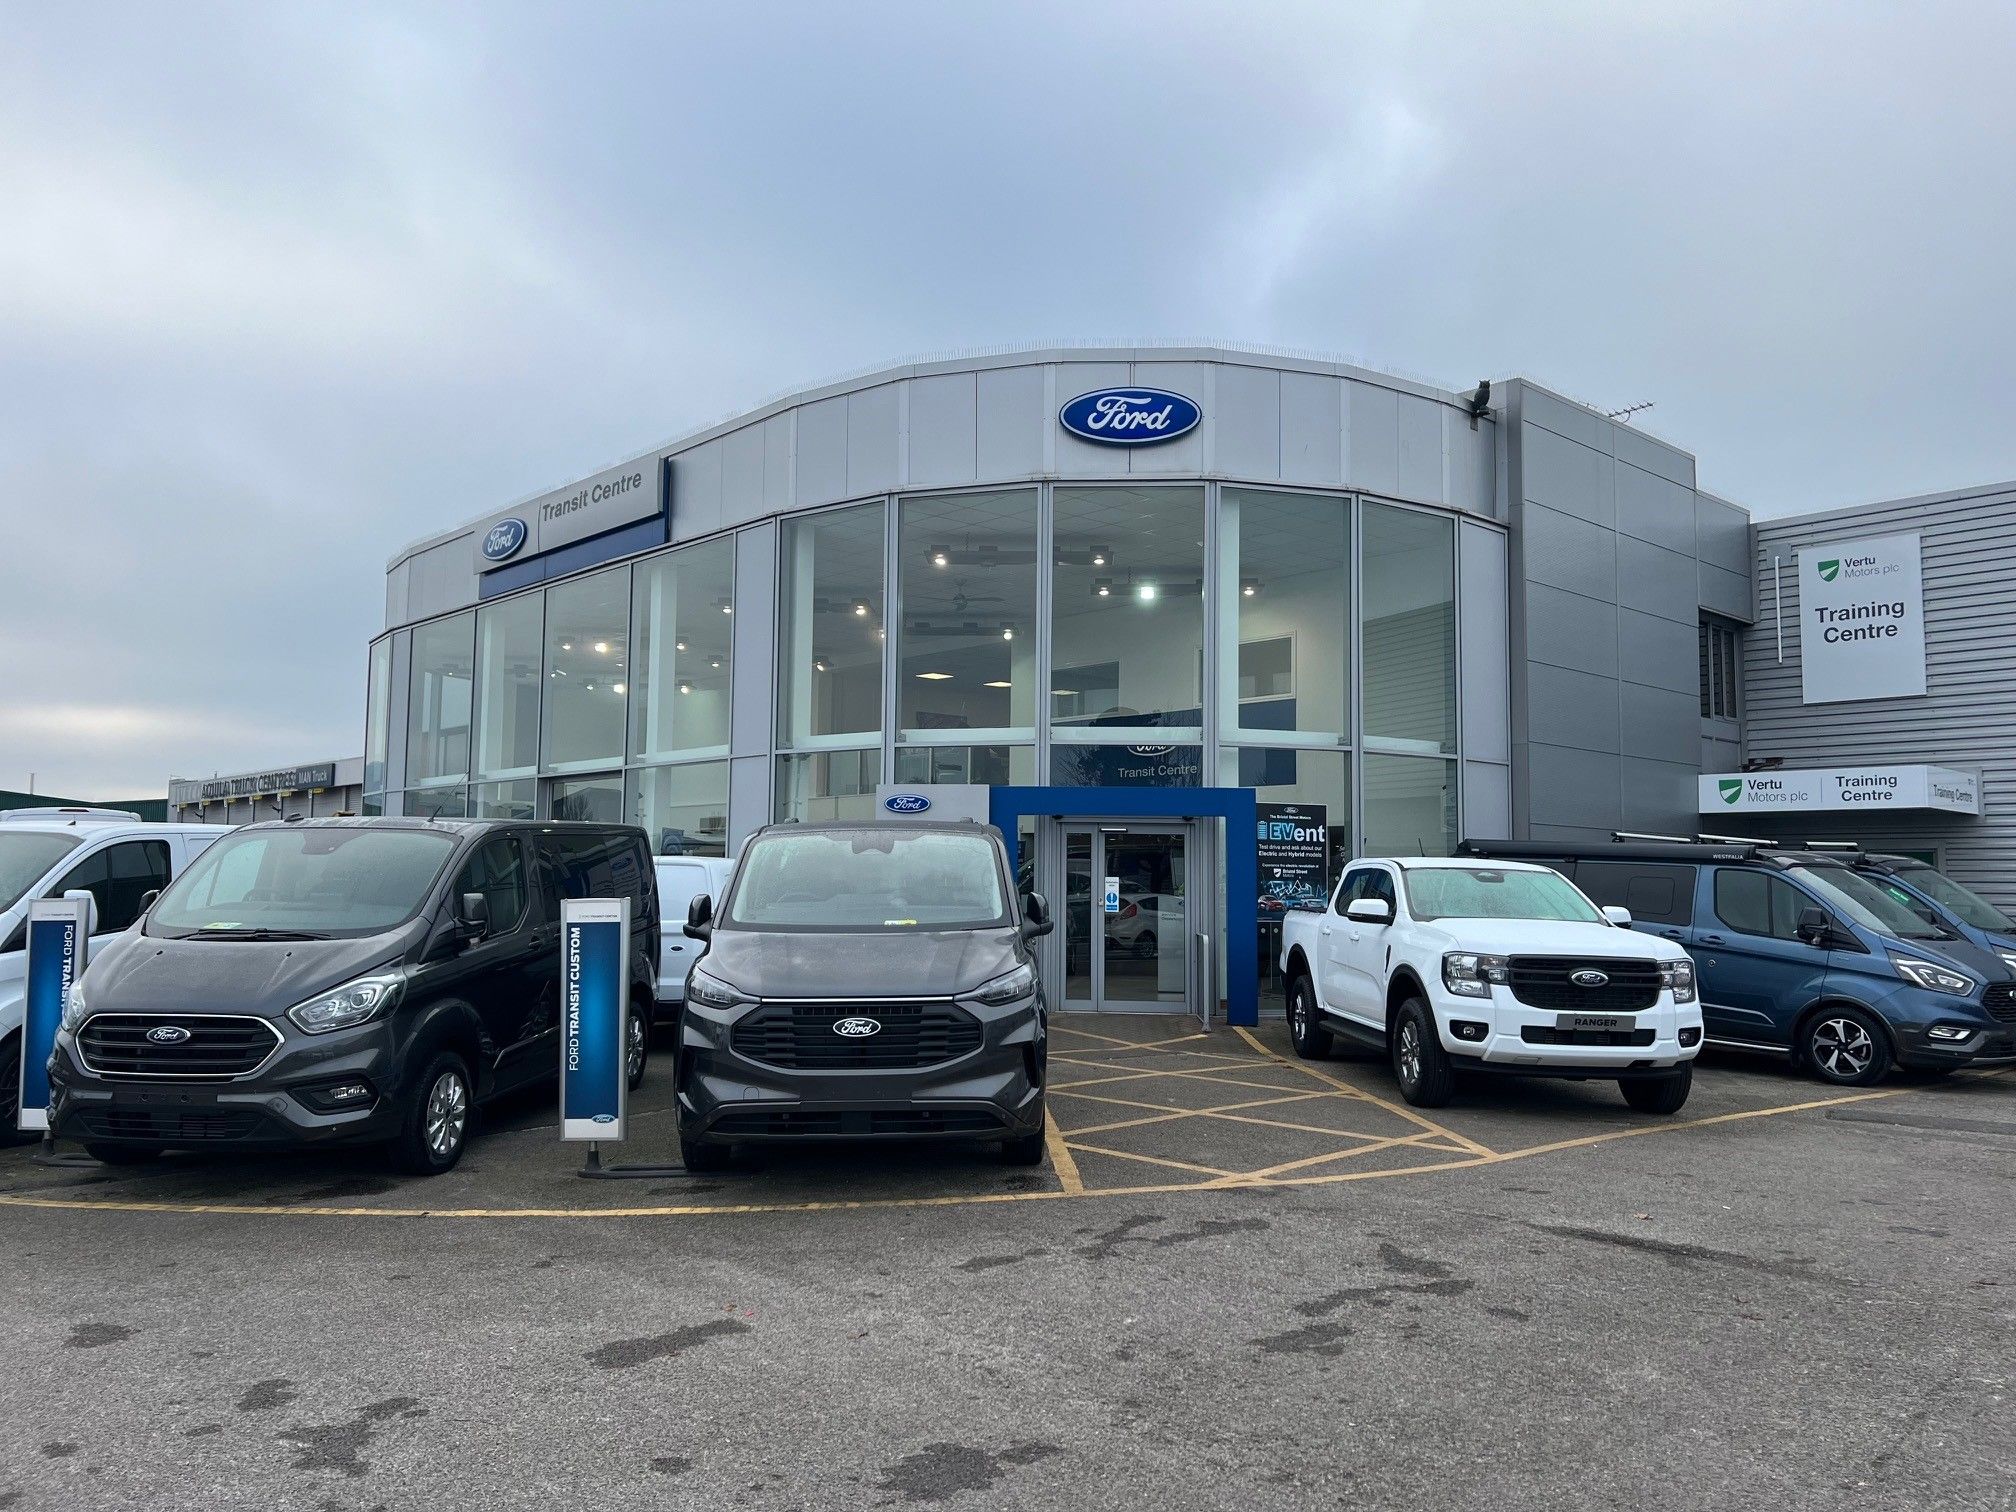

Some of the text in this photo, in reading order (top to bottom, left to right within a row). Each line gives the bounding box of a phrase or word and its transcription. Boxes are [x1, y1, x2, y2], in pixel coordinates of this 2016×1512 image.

[1087, 396, 1173, 429] Ford
[543, 472, 642, 521] Transit Centre
[1845, 556, 1876, 567] Vertu
[1845, 563, 1900, 578] Motors plc
[1815, 601, 1905, 623] Training
[1824, 624, 1898, 643] Centre
[312, 769, 328, 782] Truck
[1118, 764, 1197, 778] Transit Centre
[1747, 779, 1782, 790] Vertu
[1835, 775, 1898, 788] Training
[1747, 791, 1808, 804] Motors plc
[1841, 790, 1893, 801] Centre
[1933, 784, 1973, 802] Training Centre
[1269, 822, 1325, 842] EVent
[60, 925, 74, 1008] FORD TRANS
[568, 927, 581, 1071] FORD TRANSIT CUSTOM
[1574, 1018, 1618, 1027] RANGER
